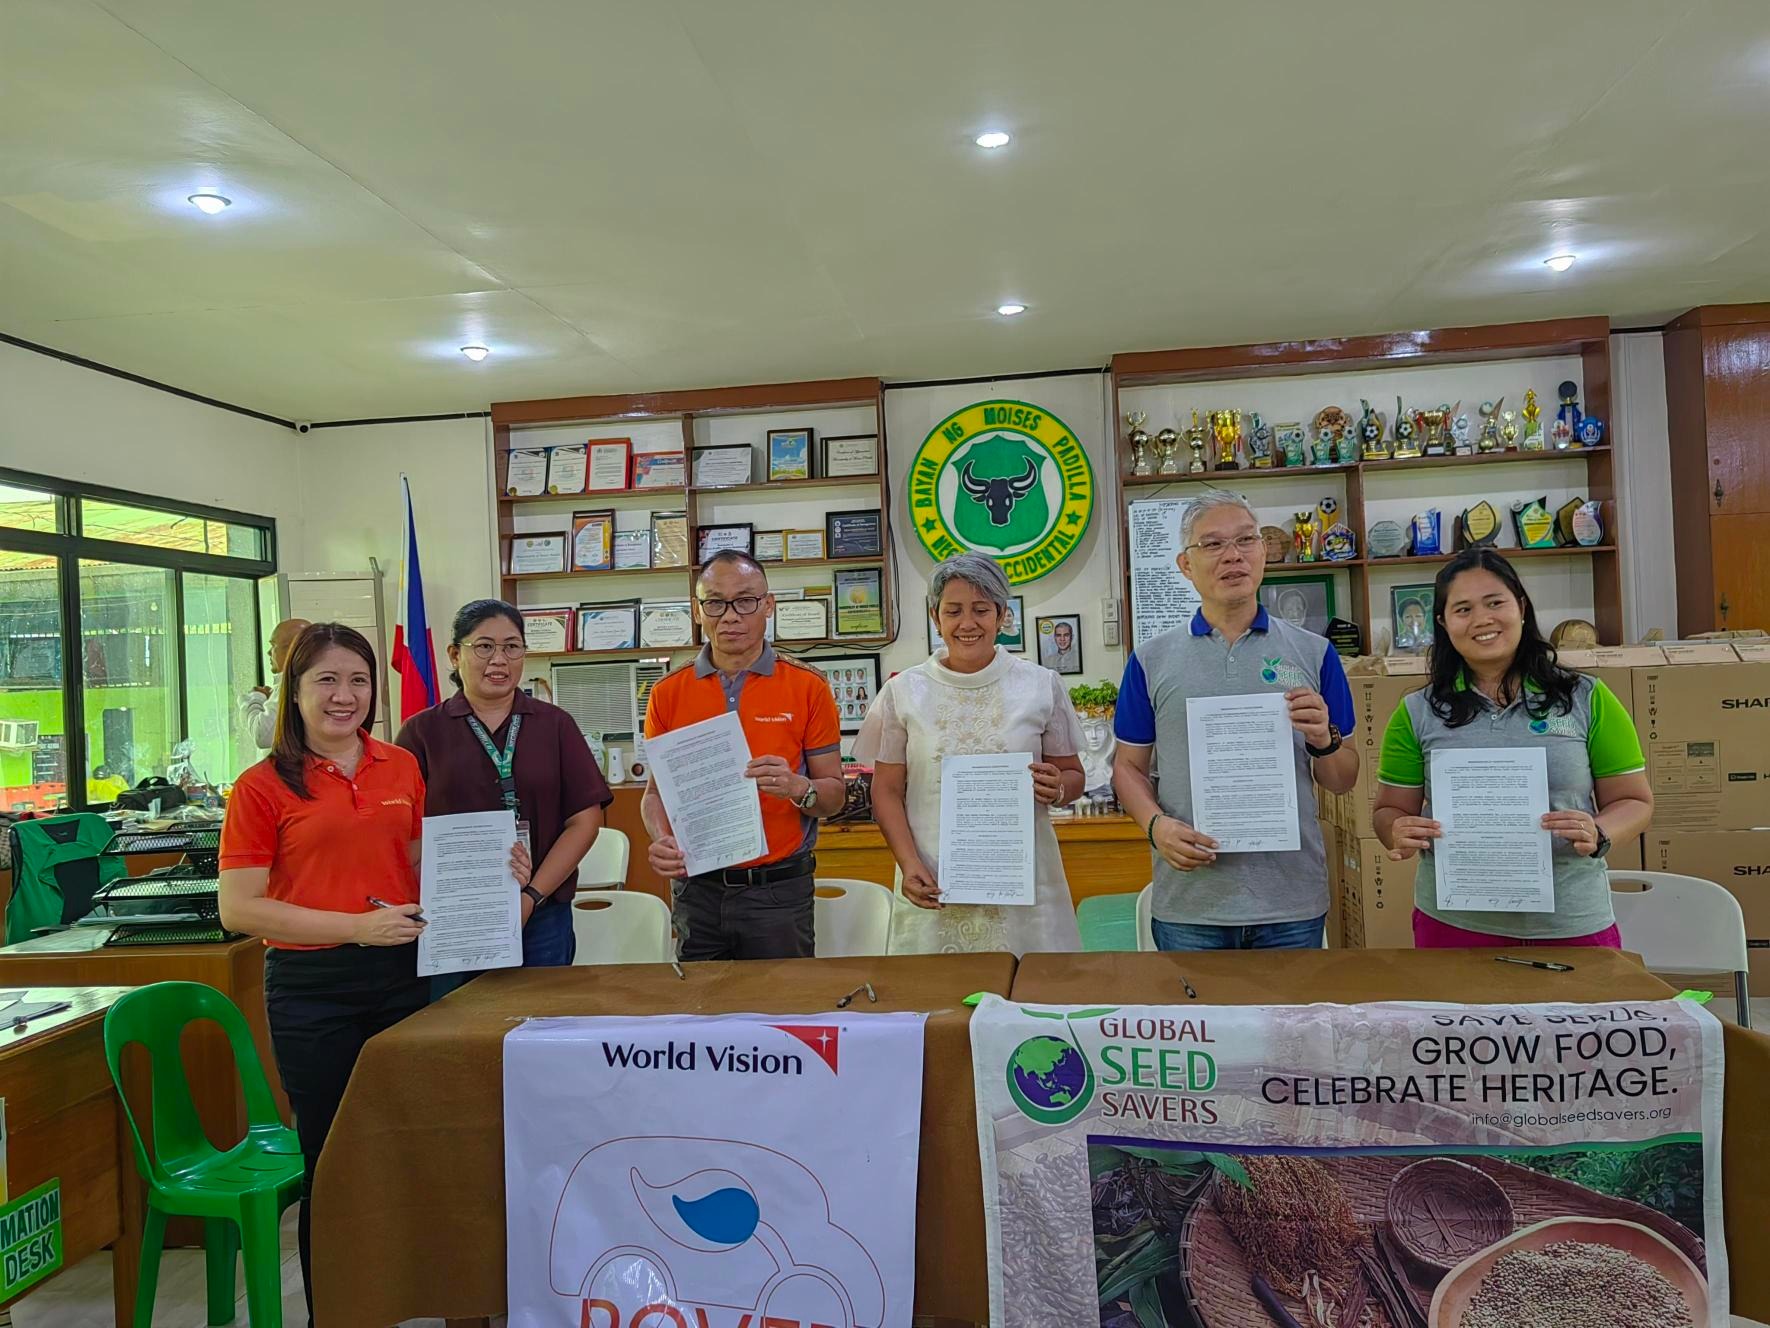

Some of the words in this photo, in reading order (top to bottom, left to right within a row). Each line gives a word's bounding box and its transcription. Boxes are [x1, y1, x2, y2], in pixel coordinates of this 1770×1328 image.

[915, 458, 938, 508] BAYAN
[942, 422, 964, 444] NG
[983, 407, 1042, 432] MOISES
[1052, 435, 1088, 501] PADILLA
[1003, 529, 1076, 580] CCIDENTAL
[1721, 697, 1770, 709] SHA
[1099, 1017, 1216, 1043] GLOBAL
[1412, 1034, 1541, 1066] GROW
[1556, 1026, 1677, 1063] FOOD,
[602, 1041, 696, 1071] World
[706, 1045, 803, 1075] Vision
[1099, 1045, 1217, 1092] SEED
[1261, 1074, 1467, 1106] CELEBRATE
[1481, 1065, 1679, 1103] HERITAGE.
[1101, 1091, 1219, 1125] SAVERS
[1471, 1106, 1672, 1127] info@globalseedsavers.org
[6, 1231, 55, 1288] DESK
